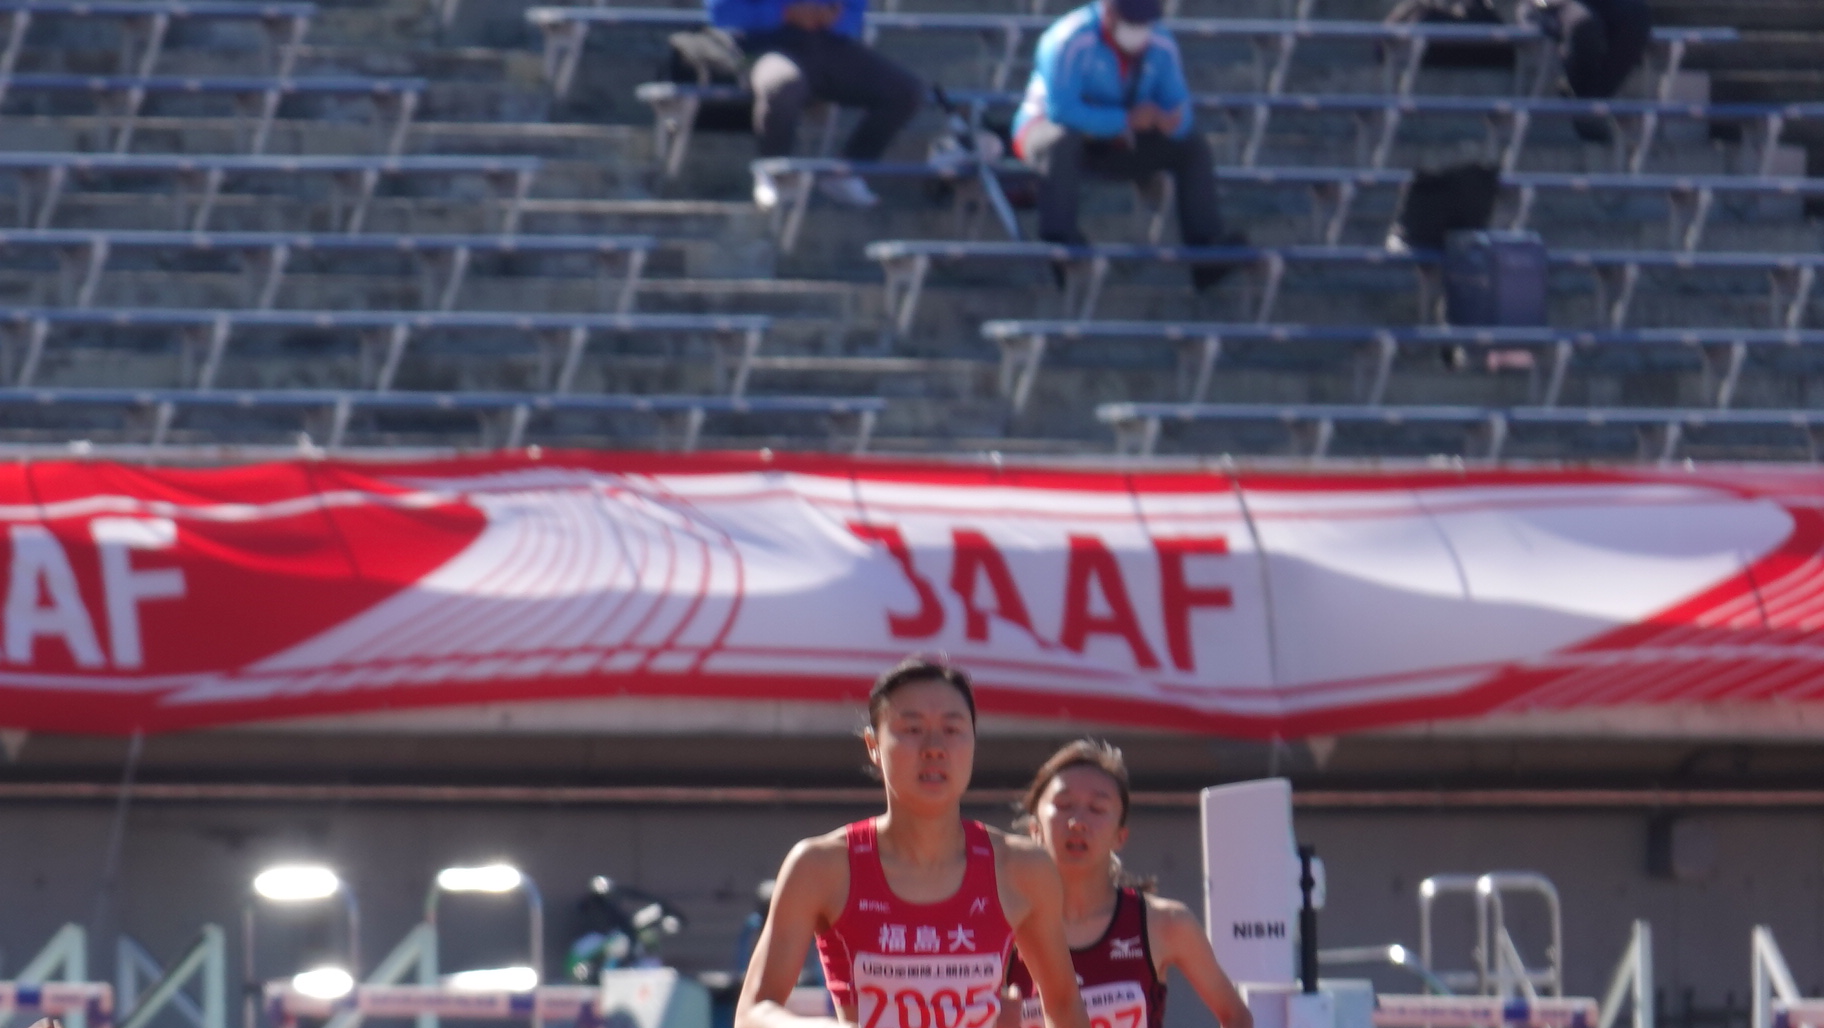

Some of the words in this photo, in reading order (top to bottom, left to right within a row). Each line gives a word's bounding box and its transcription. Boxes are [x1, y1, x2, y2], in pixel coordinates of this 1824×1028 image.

[845, 522, 1233, 672] JAAF
[879, 923, 976, 953] 福島大
[1232, 921, 1285, 939] NISHI
